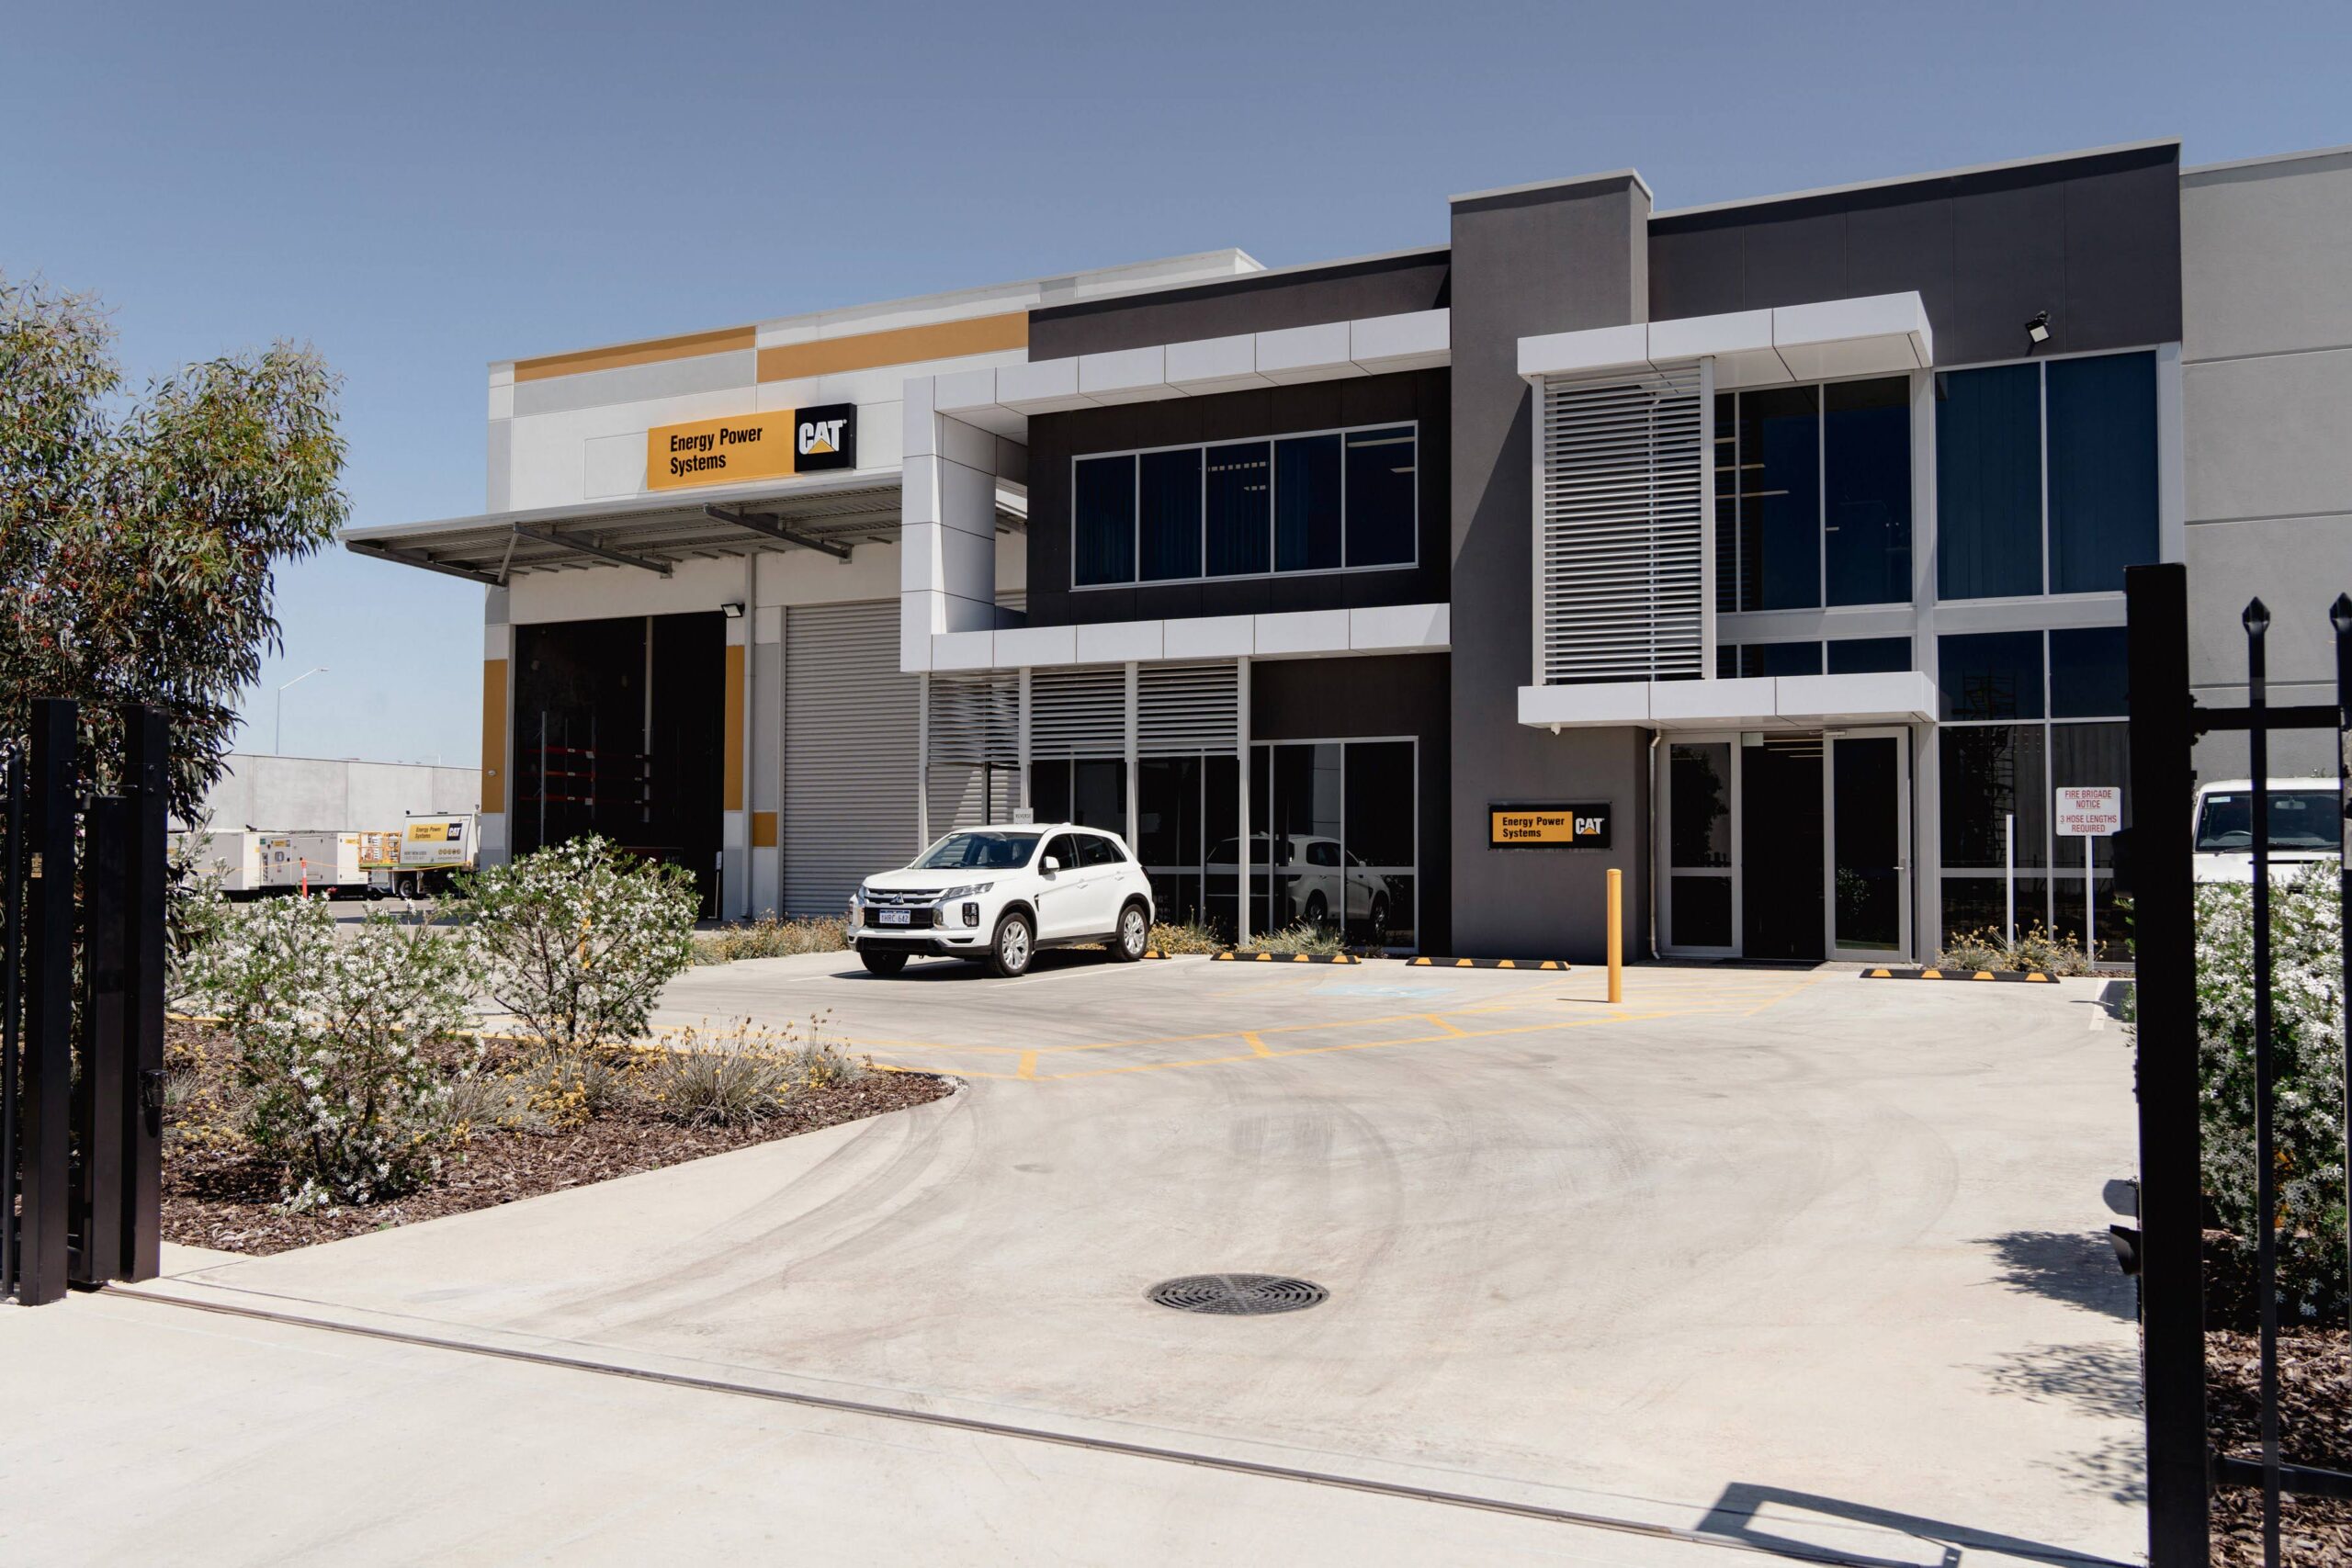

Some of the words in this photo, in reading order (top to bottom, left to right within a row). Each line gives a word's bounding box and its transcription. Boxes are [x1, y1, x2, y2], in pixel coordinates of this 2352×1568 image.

[670, 434, 715, 452] Energy
[719, 427, 763, 446] Power
[798, 419, 843, 455] CAT
[670, 454, 727, 477] Systems
[2064, 790, 2079, 798] FIRE
[2081, 790, 2112, 798] BRIGADE
[2075, 800, 2101, 808] NOTICE
[1502, 817, 1533, 828] Energy
[1536, 817, 1565, 826] Power
[2065, 815, 2084, 823] HOSE
[2086, 815, 2117, 823] LENGTHS
[448, 827, 460, 837] CAT
[1575, 818, 1603, 835] CAT
[2072, 824, 2106, 832] REQUIRED
[1502, 828, 1542, 839] Systems
